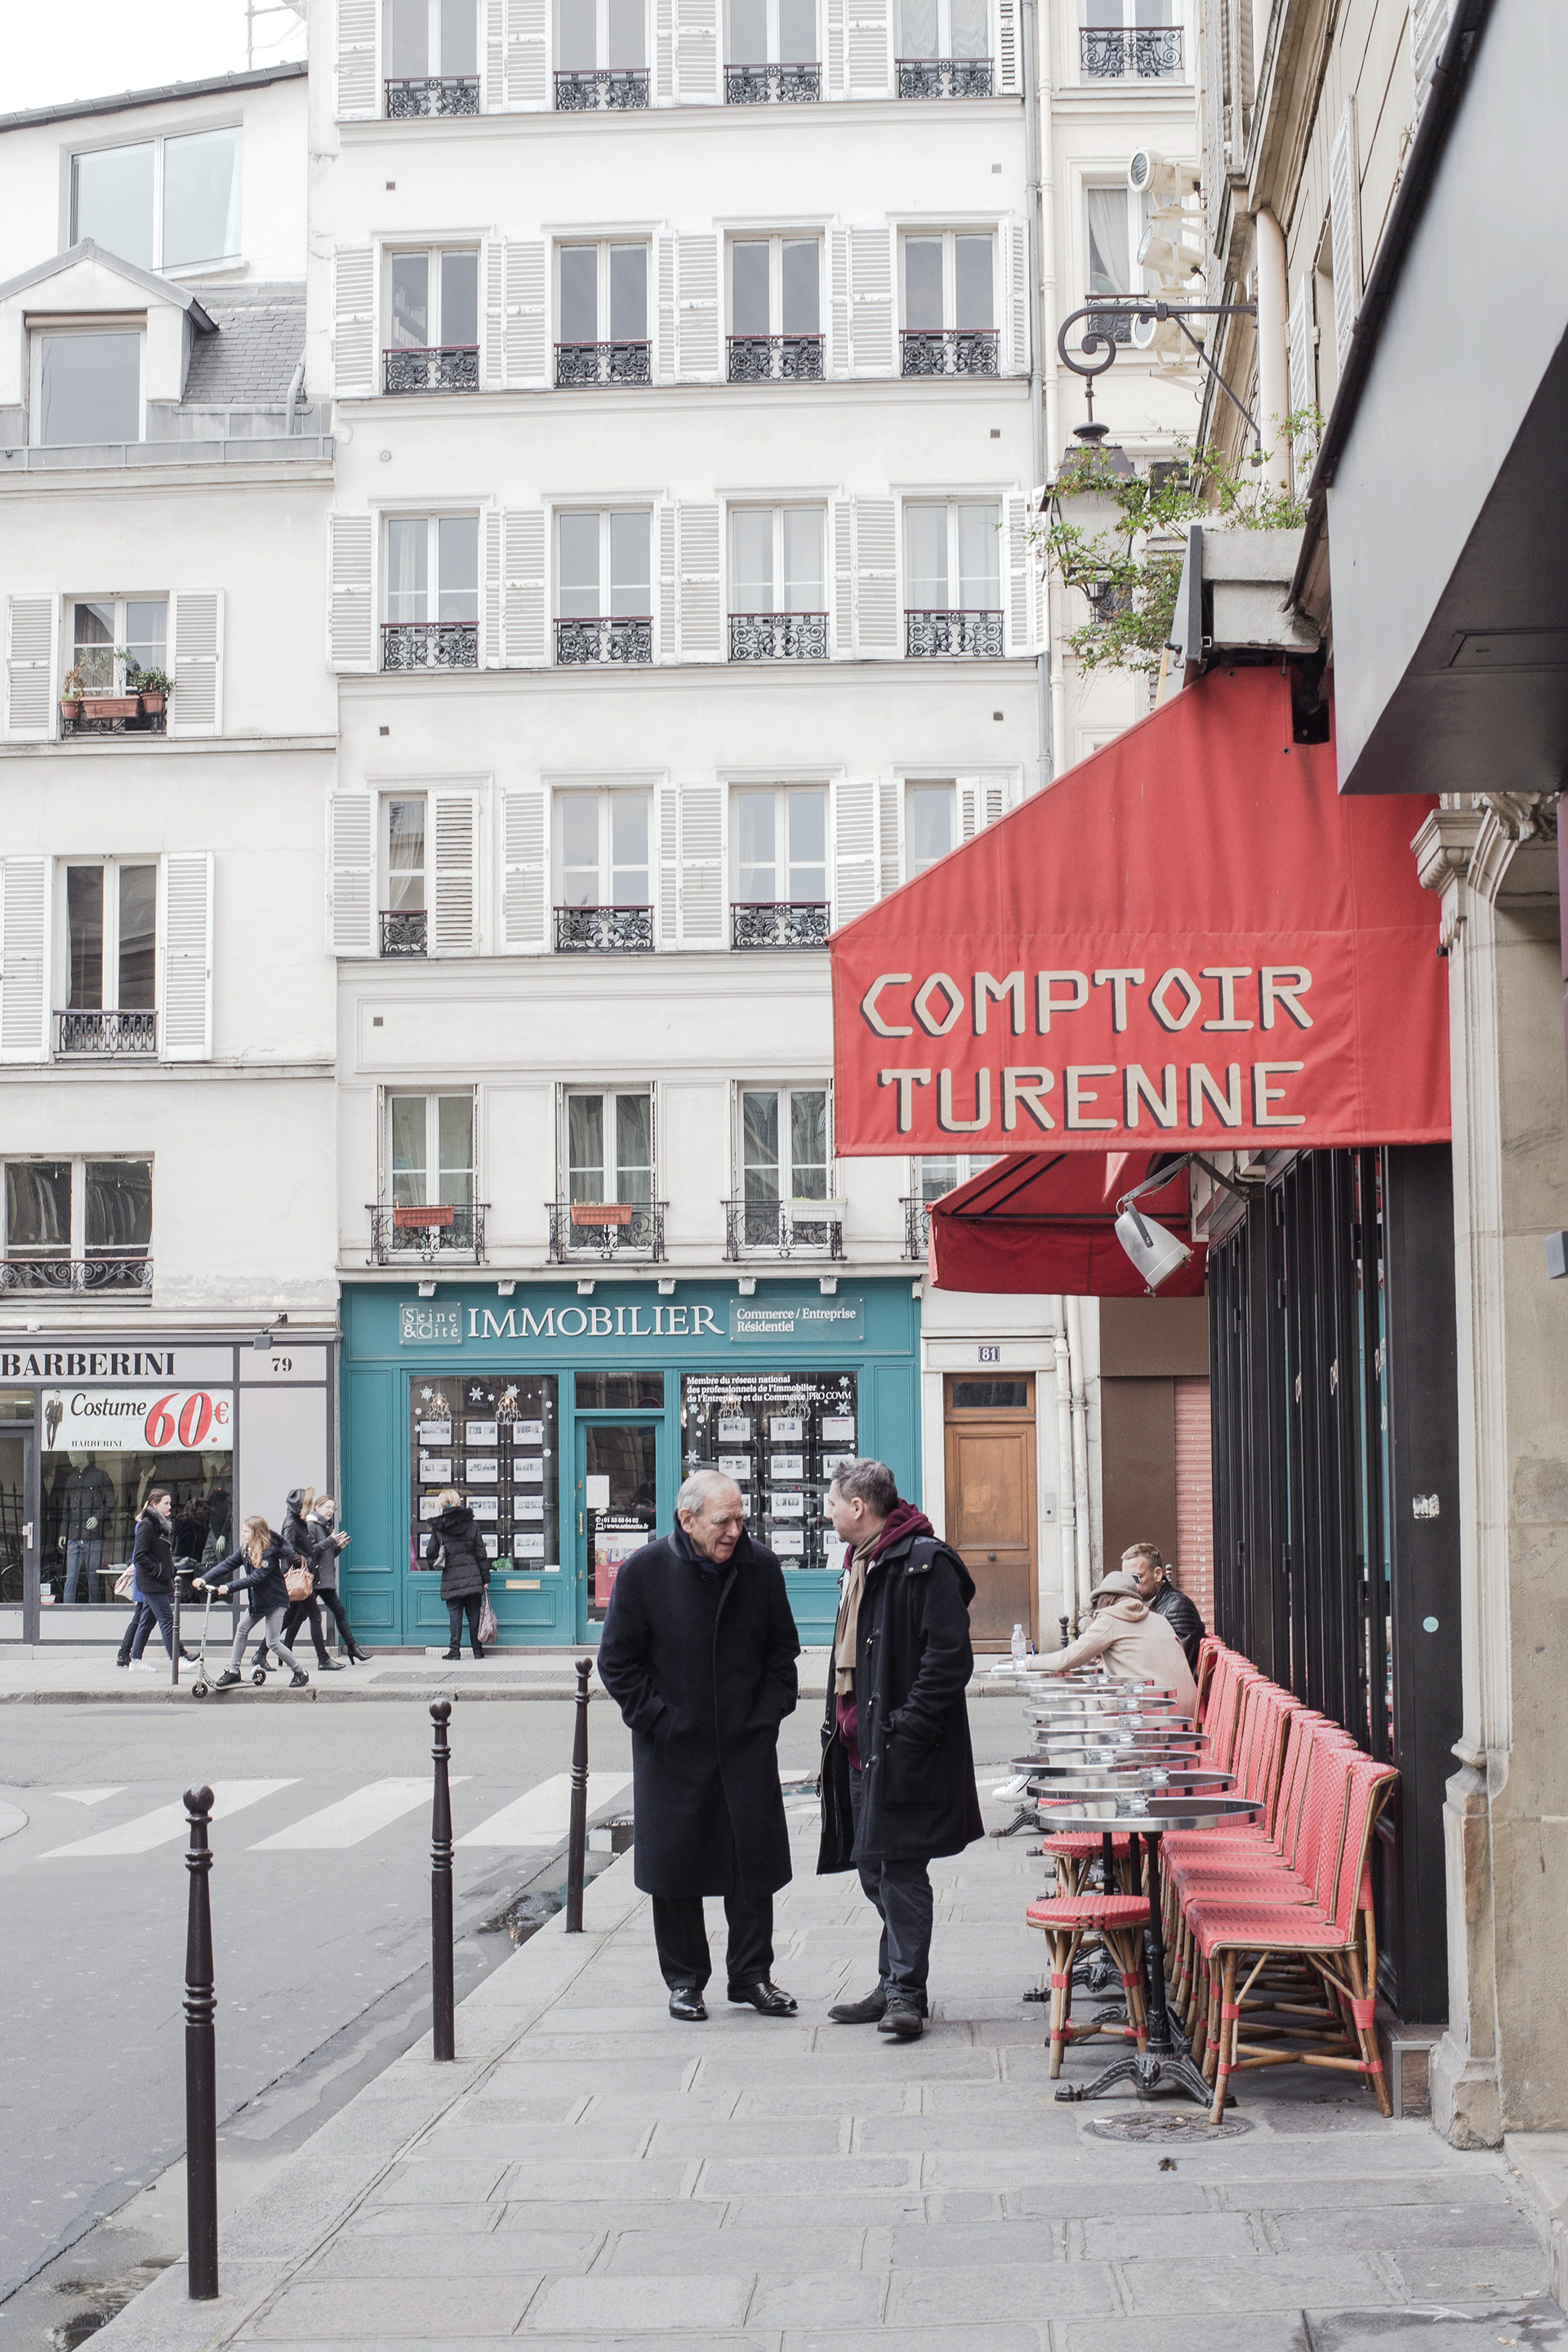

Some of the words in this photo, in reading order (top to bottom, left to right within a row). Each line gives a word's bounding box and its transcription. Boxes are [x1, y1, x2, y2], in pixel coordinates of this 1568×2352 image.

[860, 965, 1313, 1037] COMPTOIR
[878, 1061, 1307, 1132] TURENNE
[405, 1308, 457, 1323] Seine
[468, 1306, 725, 1339] IMMOBILIER
[737, 1308, 795, 1320] Commerce
[802, 1308, 857, 1322] Entreprise
[737, 1320, 795, 1333] Résidentiel
[982, 1348, 996, 1361] 81
[1, 1352, 176, 1376] BARBERINI
[271, 1357, 292, 1372] 79
[686, 1376, 719, 1385] Membre
[719, 1375, 731, 1384] du
[732, 1375, 757, 1384] réseau
[758, 1374, 791, 1383] national
[687, 1385, 700, 1394] des
[701, 1383, 757, 1396] professionnels
[758, 1383, 768, 1393] de
[70, 1393, 147, 1416] Costume
[687, 1394, 697, 1403] de
[743, 1393, 751, 1402] et
[752, 1392, 762, 1401] du
[764, 1392, 806, 1401] Commerce
